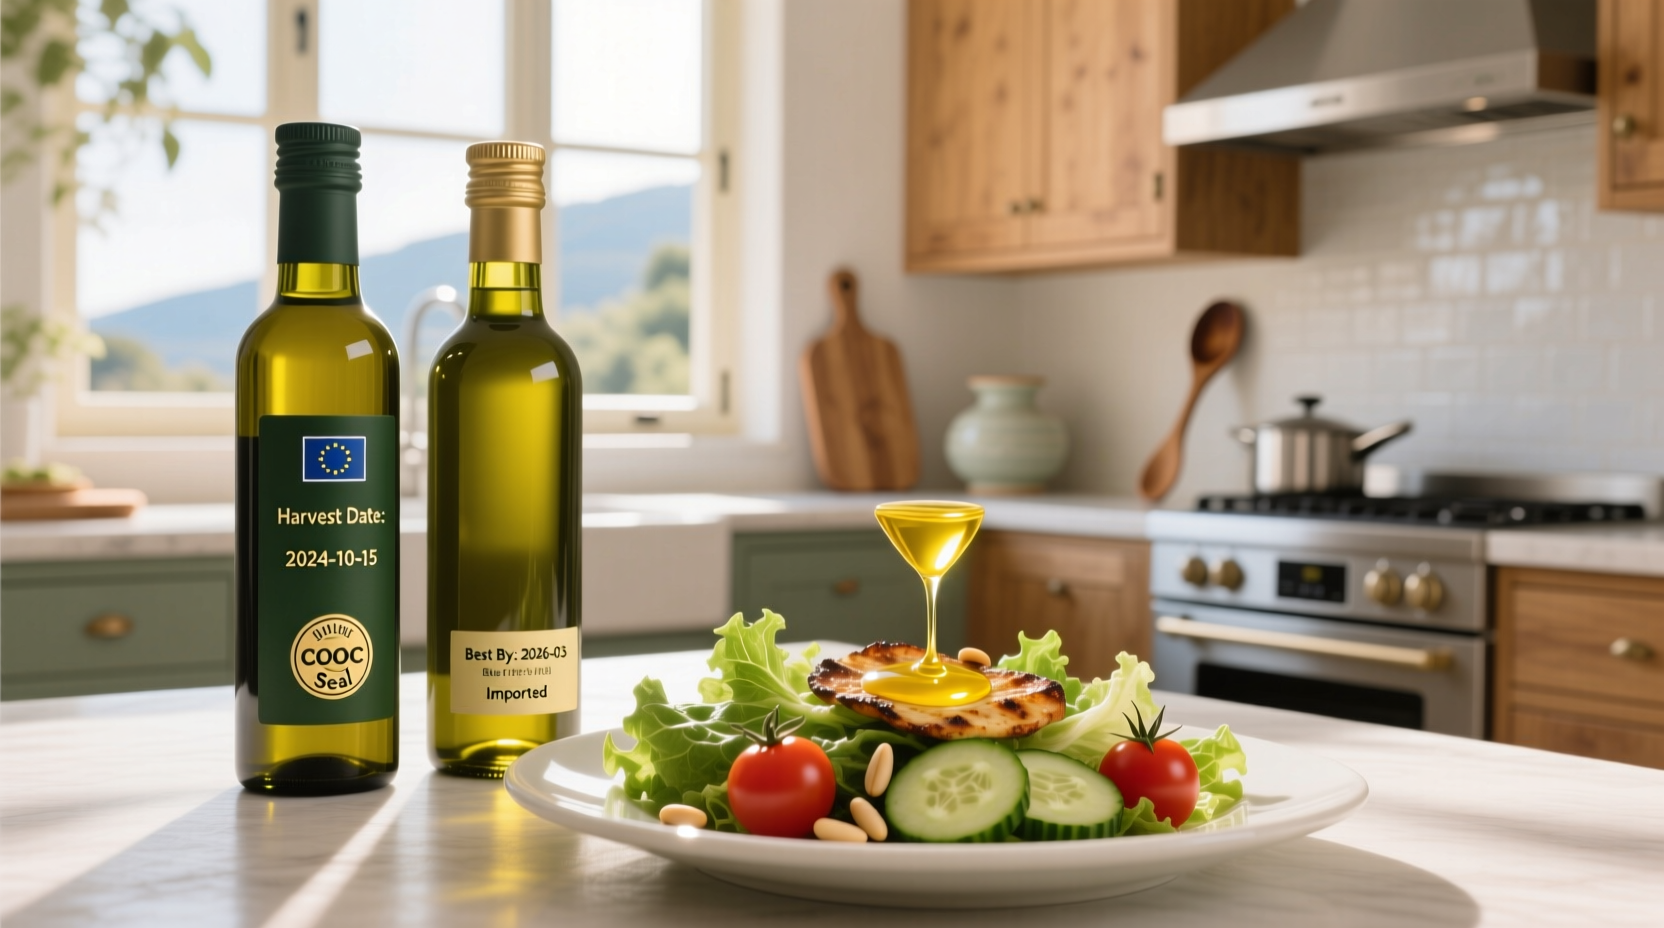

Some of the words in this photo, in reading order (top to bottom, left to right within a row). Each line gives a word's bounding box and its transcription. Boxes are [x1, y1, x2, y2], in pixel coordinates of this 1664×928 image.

[277, 507, 343, 525] Harvest
[346, 506, 386, 524] Date:
[285, 549, 378, 567] 2024-10-15
[300, 646, 364, 666] COOC
[465, 647, 493, 661] Best
[496, 648, 518, 665] By:
[313, 666, 353, 690] Seal
[486, 684, 548, 703] Imported
